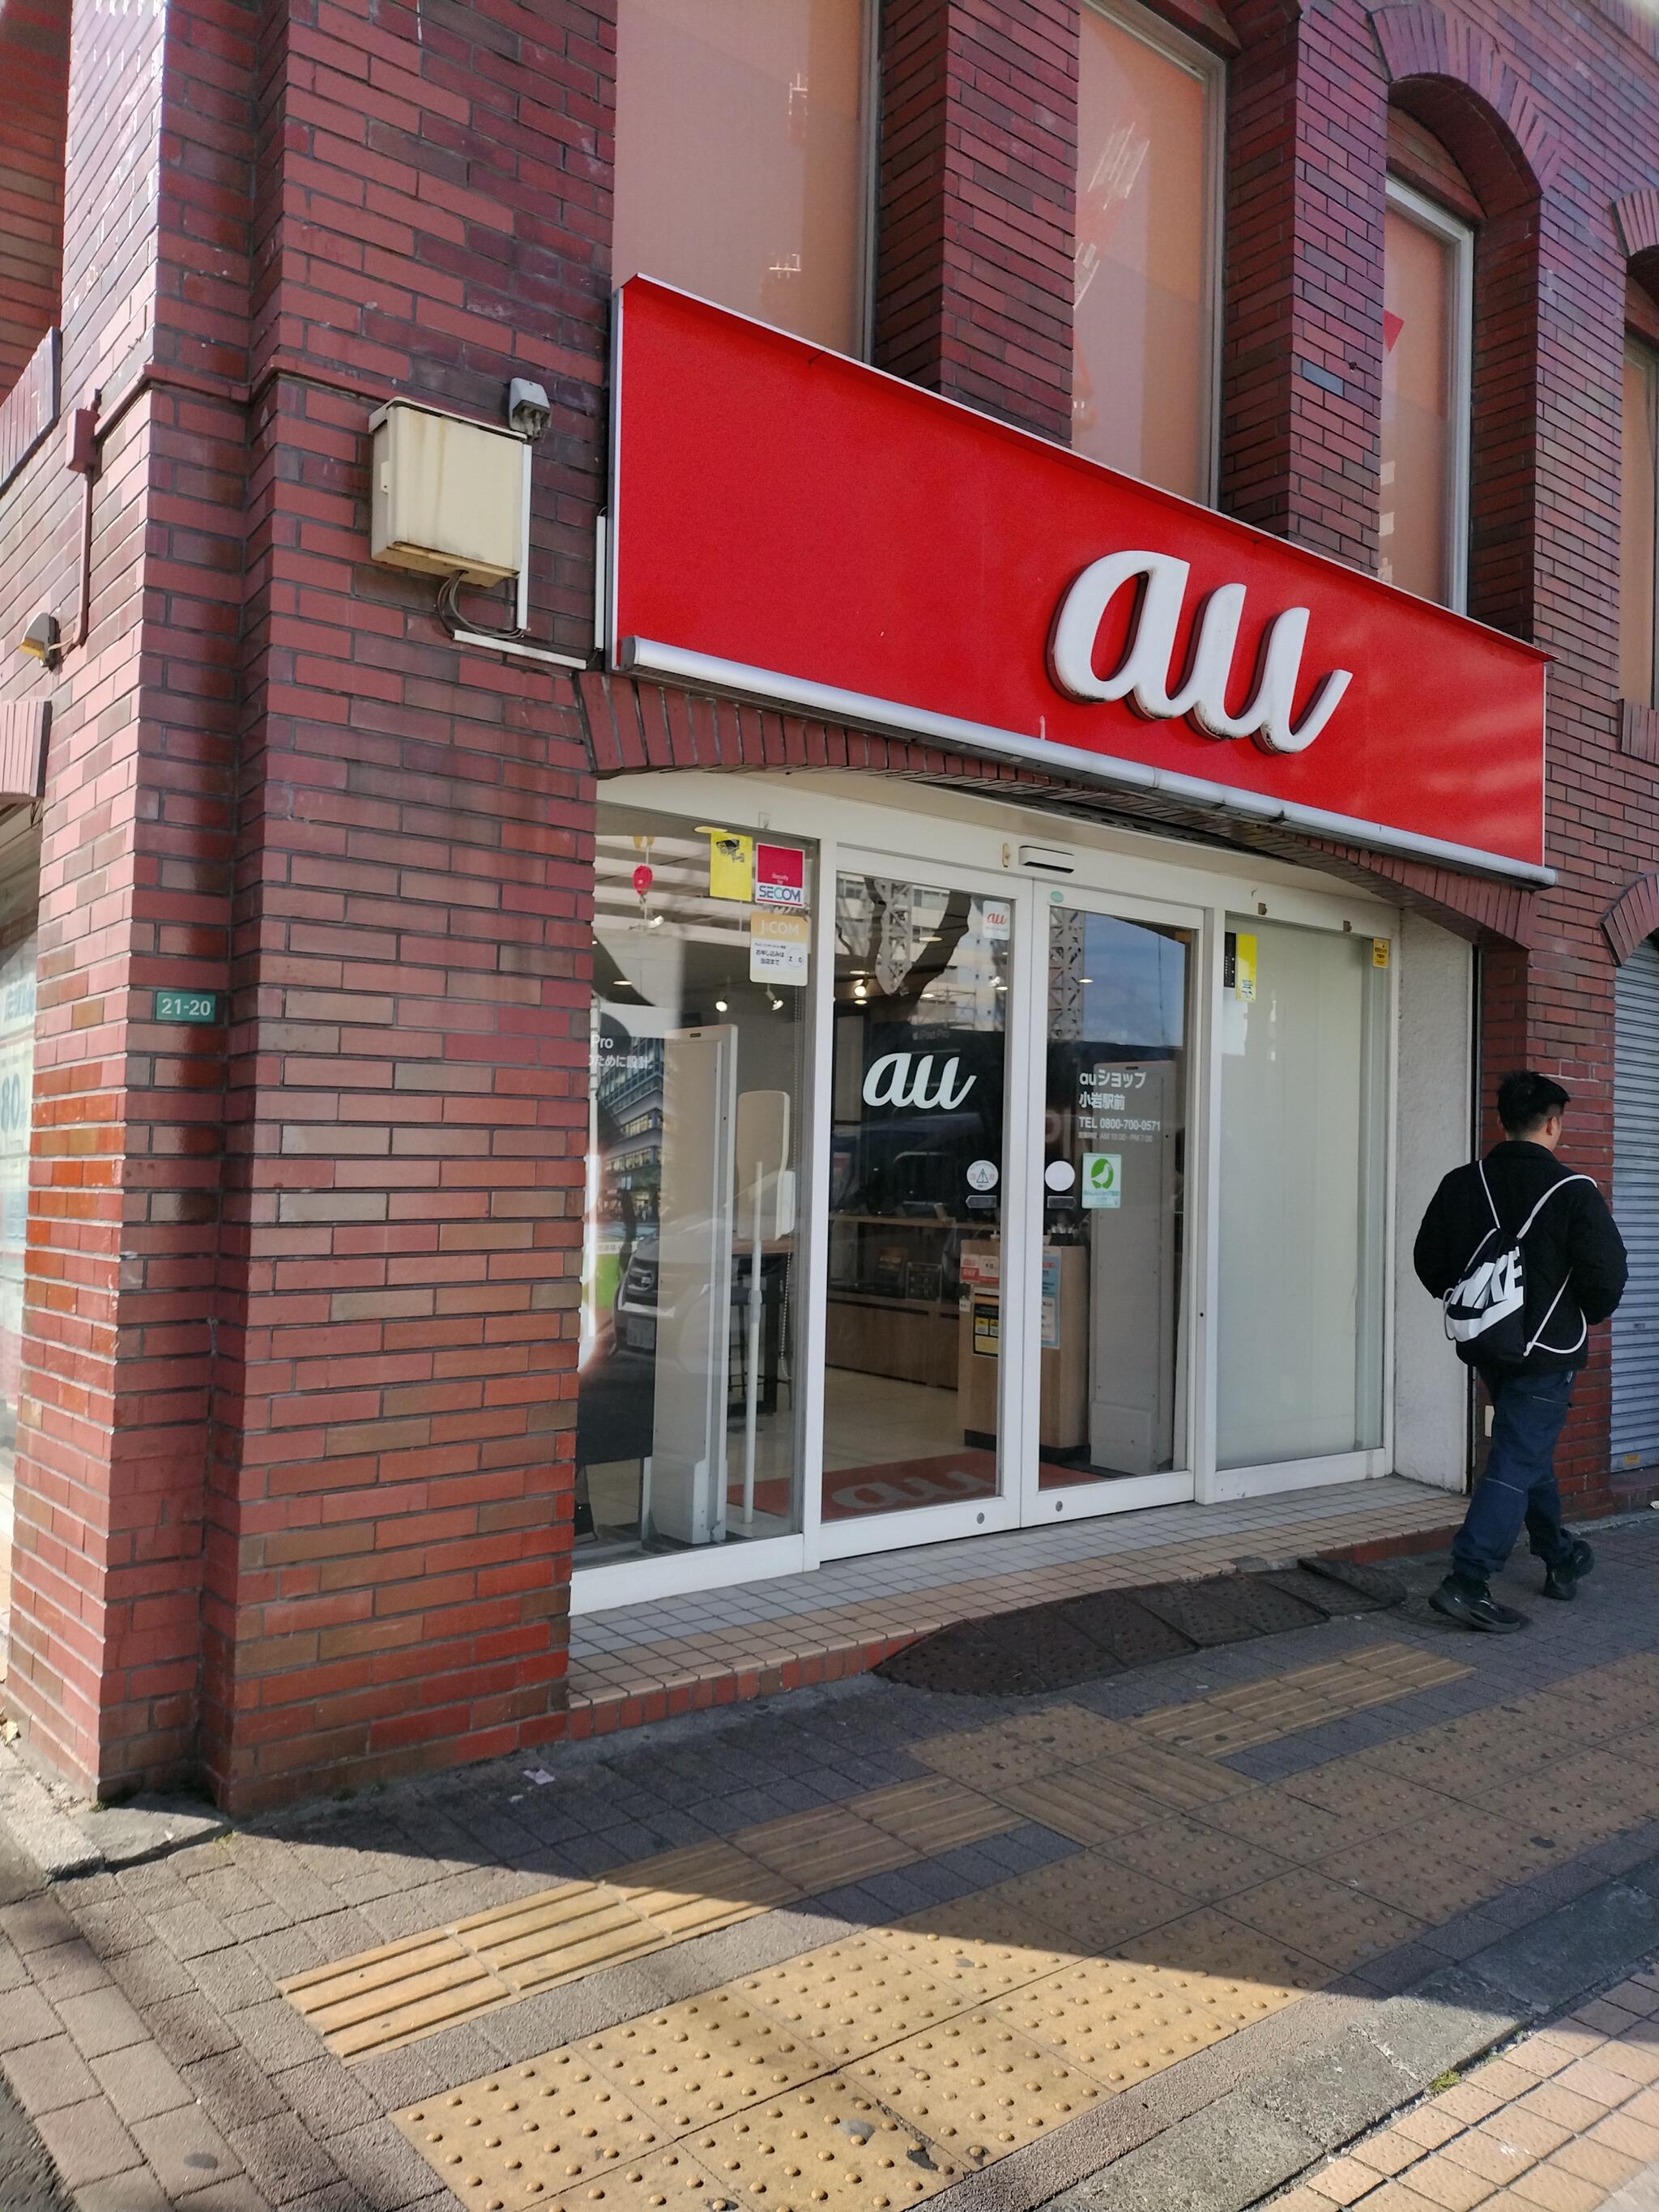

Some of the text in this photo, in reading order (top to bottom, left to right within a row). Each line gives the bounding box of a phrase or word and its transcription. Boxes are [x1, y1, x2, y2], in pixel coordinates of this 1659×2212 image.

[1045, 550, 1354, 755] au
[759, 885, 801, 902] SECOM
[987, 913, 1009, 925] au
[161, 998, 211, 1016] 21-20
[591, 1034, 613, 1049] Pro
[862, 1052, 977, 1110] au
[1079, 1069, 1147, 1089] auショップ
[1079, 1091, 1125, 1110] 小岩駅前
[1078, 1117, 1161, 1132] TEL 0800-700-0571
[1445, 1247, 1524, 1309] NIKE
[831, 1470, 996, 1508] au
